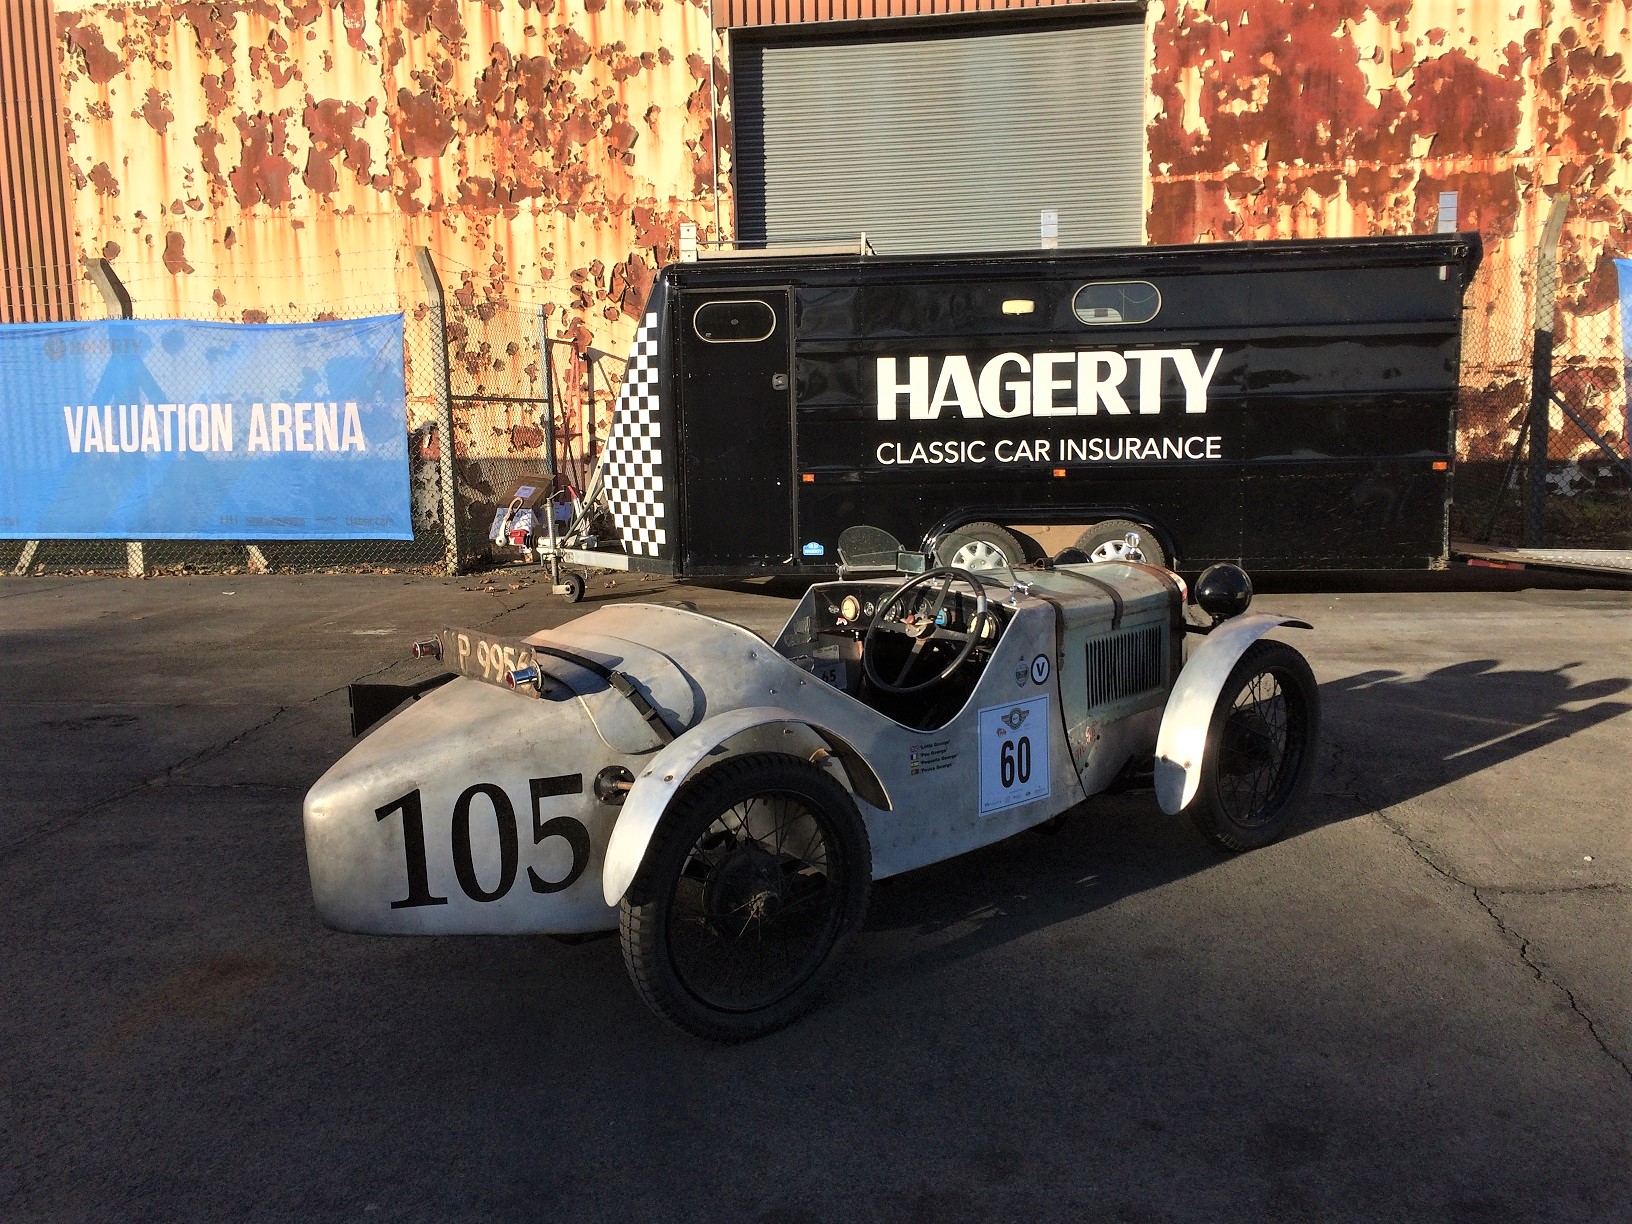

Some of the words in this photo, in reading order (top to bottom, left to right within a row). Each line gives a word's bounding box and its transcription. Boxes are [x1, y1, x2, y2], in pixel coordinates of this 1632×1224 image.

[876, 348, 1224, 421] HAGERTY
[63, 403, 233, 453] VALUATION
[247, 402, 366, 452] ARENA
[876, 440, 986, 465] CLASSIC
[994, 439, 1051, 463] CAR
[1059, 436, 1222, 461] INSURANCE
[1000, 736, 1031, 788] 60
[374, 773, 591, 909] 105
